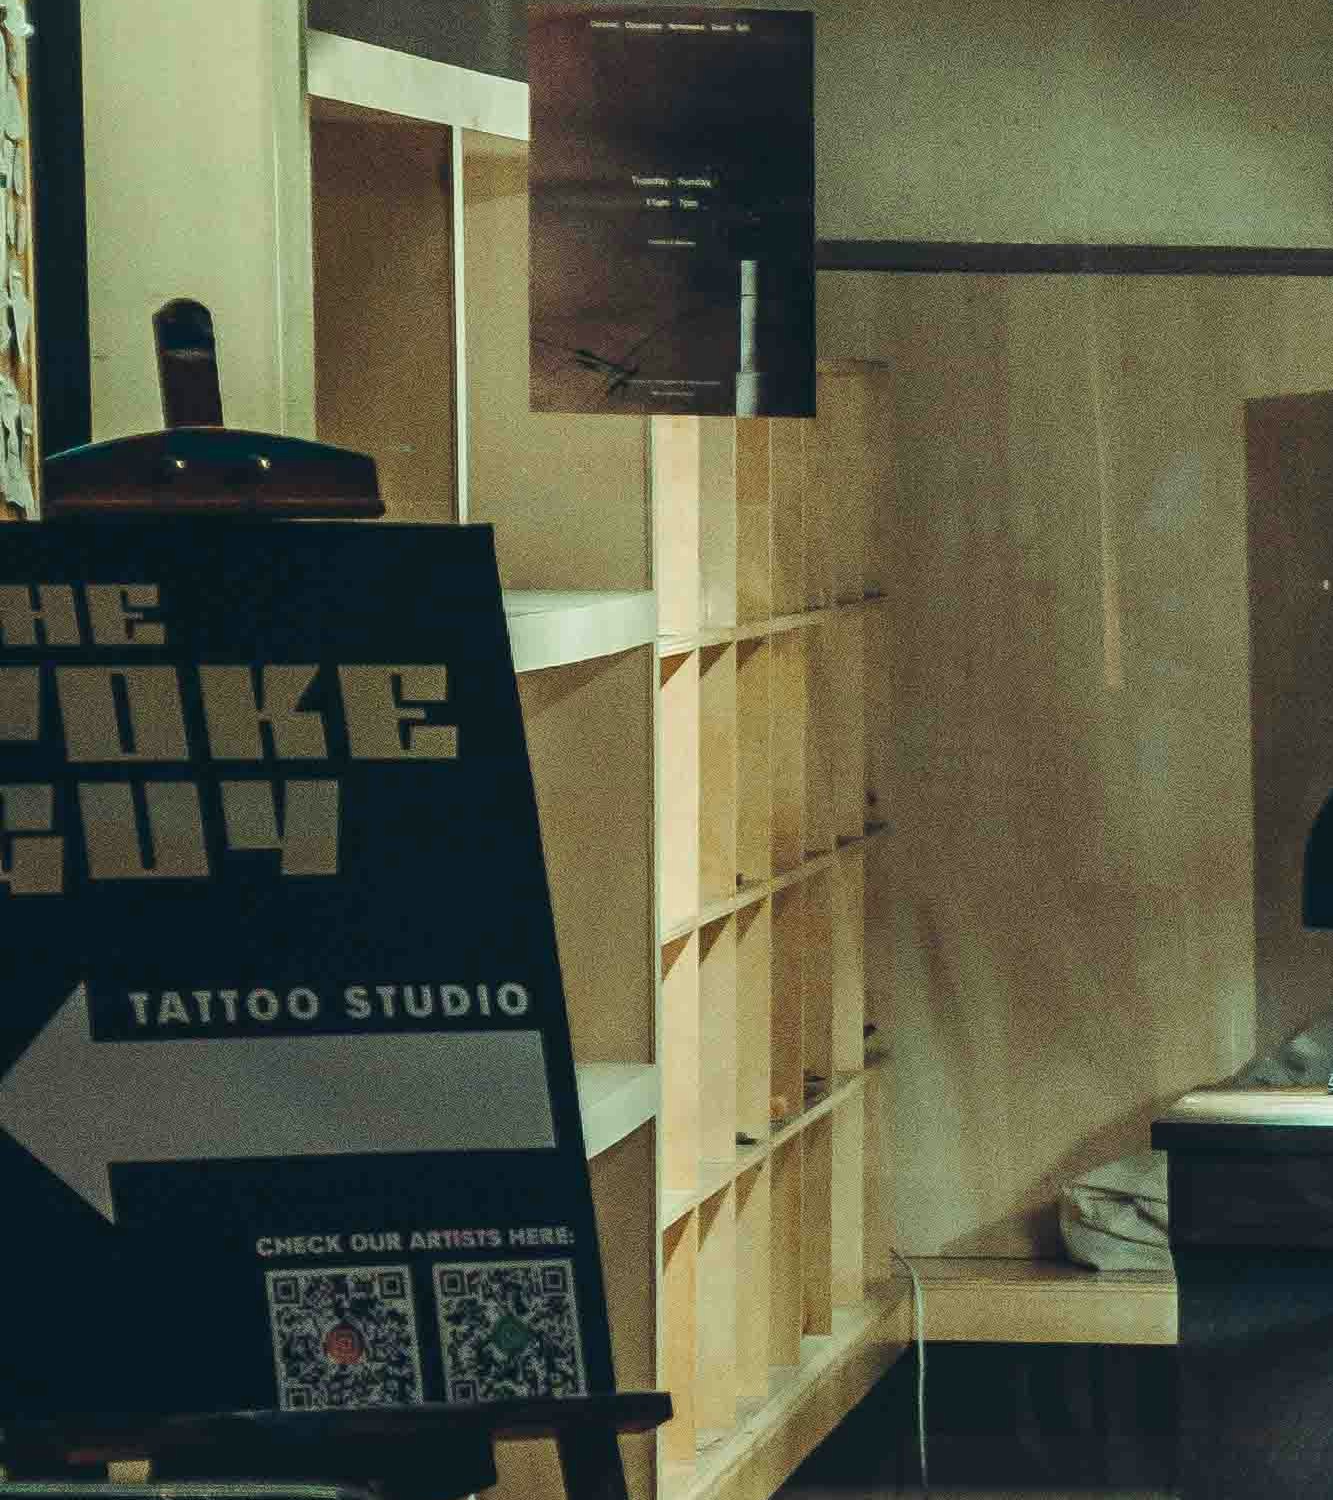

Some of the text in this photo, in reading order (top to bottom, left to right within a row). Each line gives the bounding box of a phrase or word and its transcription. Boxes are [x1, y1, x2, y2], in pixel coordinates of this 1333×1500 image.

[128, 982, 530, 1026] TATTOO STUDIO
[256, 1226, 576, 1257] CHECK OUR ARTISTS HERE:
